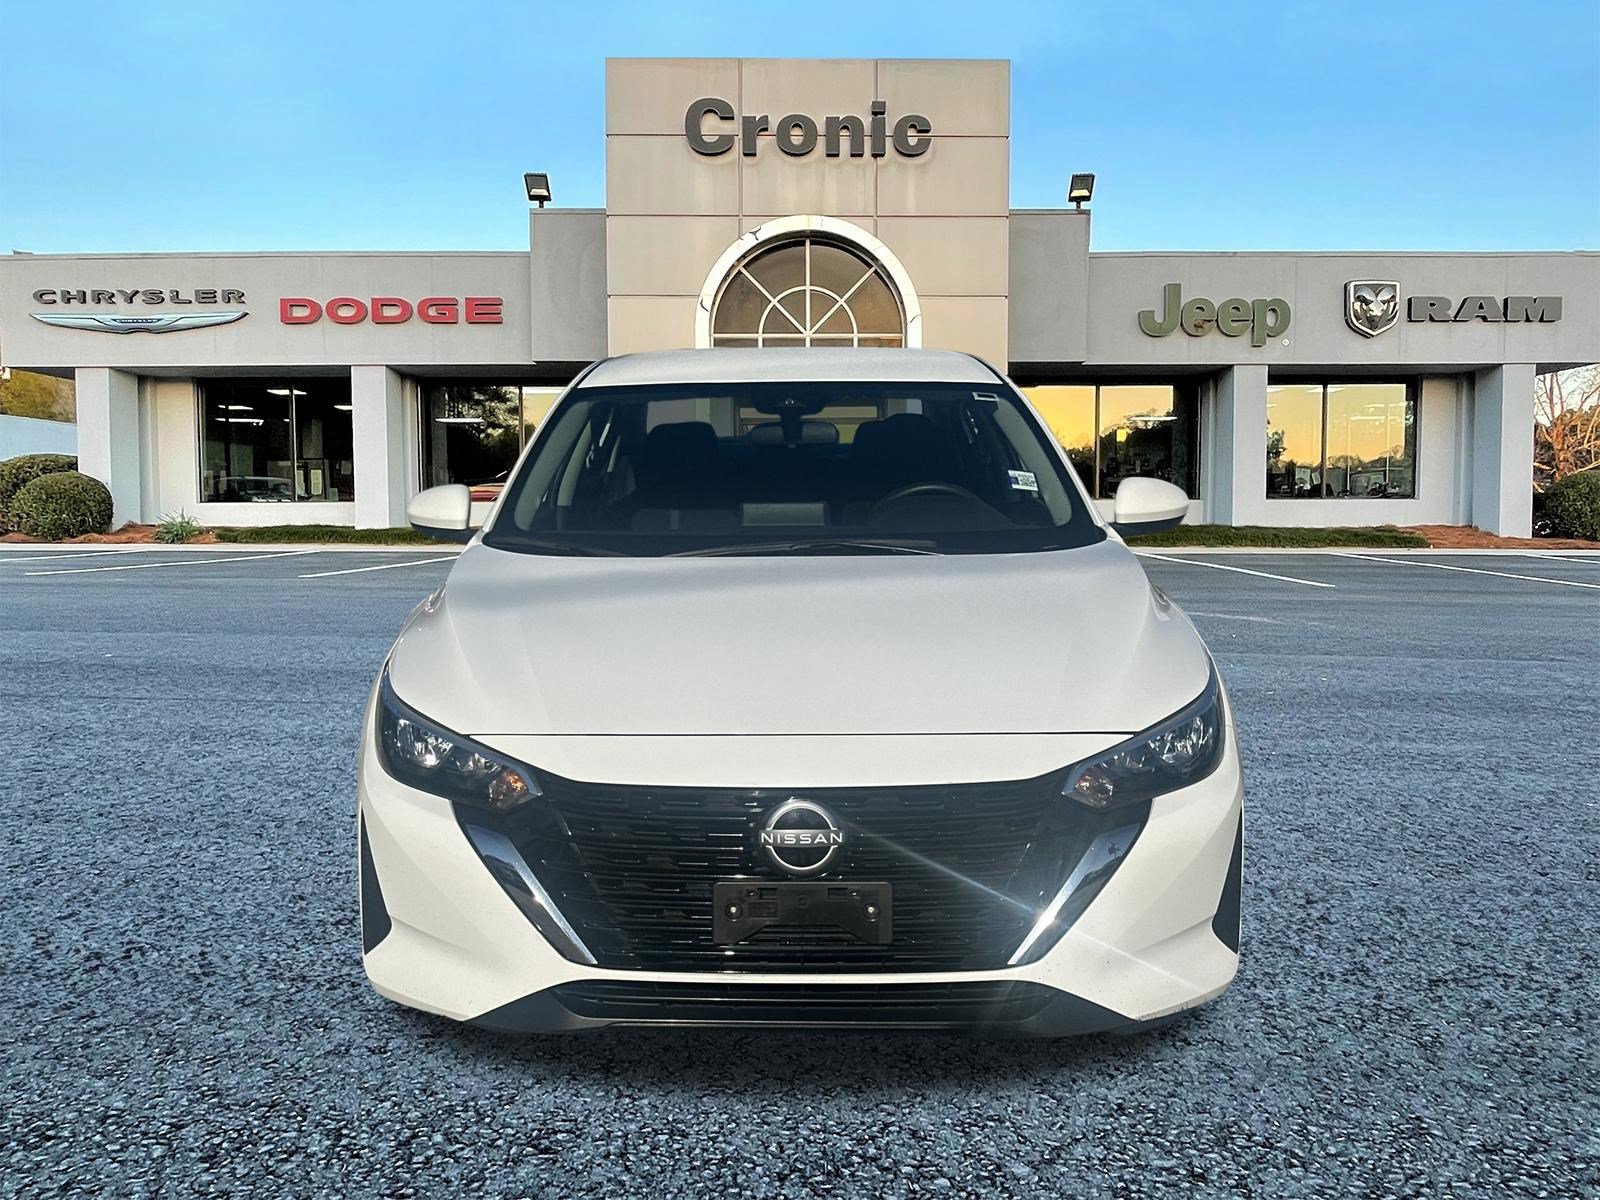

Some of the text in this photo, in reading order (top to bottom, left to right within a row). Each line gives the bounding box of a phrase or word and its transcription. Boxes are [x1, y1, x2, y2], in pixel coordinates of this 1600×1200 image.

[685, 97, 932, 157] Cronic
[32, 288, 246, 304] CHRYSLER
[1407, 296, 1563, 322] RAM
[279, 297, 503, 324] DODGE
[1138, 283, 1291, 347] Jeep
[761, 832, 843, 844] NISSAN
